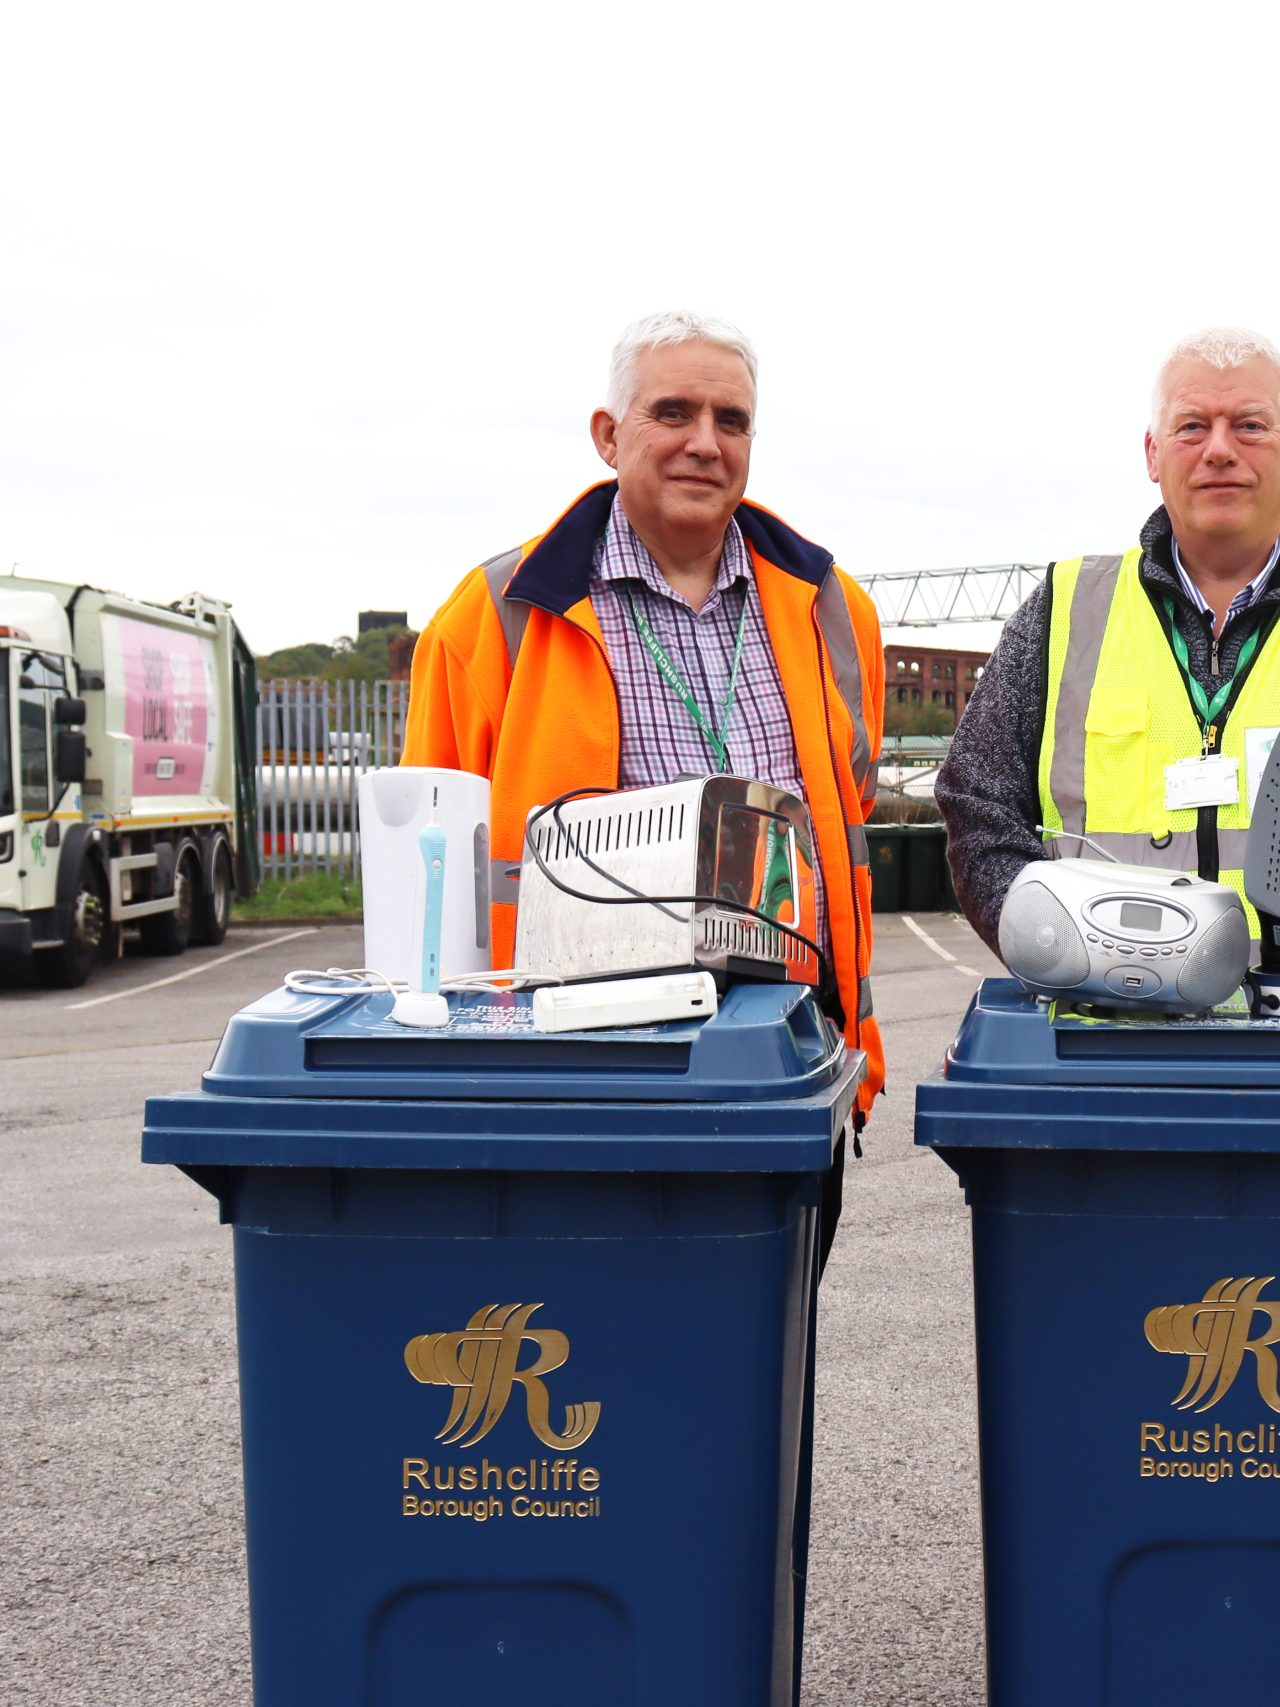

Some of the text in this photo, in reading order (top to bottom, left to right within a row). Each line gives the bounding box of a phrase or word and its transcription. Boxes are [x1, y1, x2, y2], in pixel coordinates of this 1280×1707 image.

[643, 626, 688, 700] RUSHCLIFFE
[402, 1457, 601, 1491] Rushcliffe
[1139, 1457, 1234, 1483] Borough
[402, 1495, 601, 1522] Borough Council
